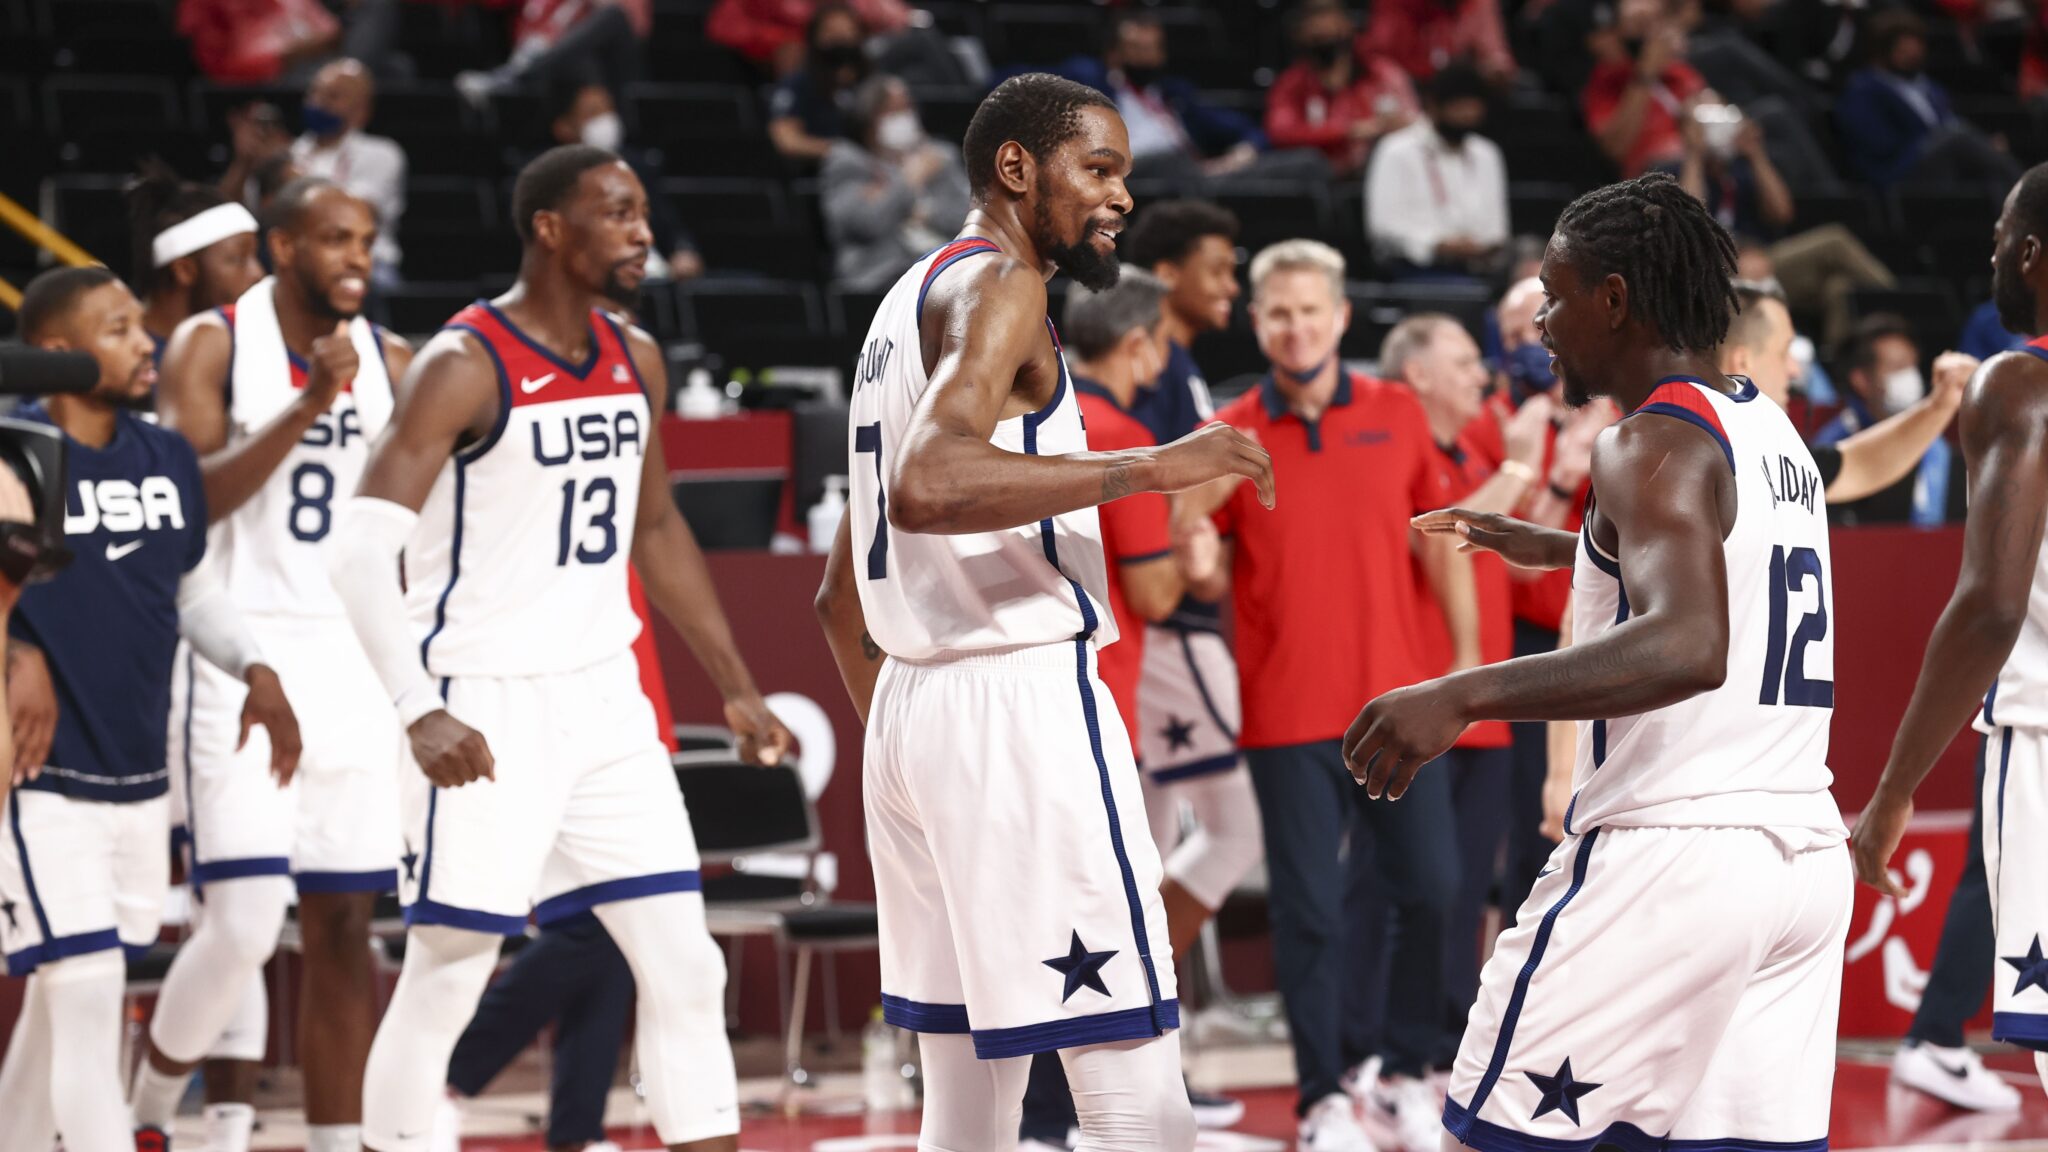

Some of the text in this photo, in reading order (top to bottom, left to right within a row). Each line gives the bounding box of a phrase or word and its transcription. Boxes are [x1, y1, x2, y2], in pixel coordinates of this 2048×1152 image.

[298, 408, 362, 448] SA
[531, 410, 641, 466] USA
[289, 461, 335, 542] 8
[557, 477, 618, 567] 13
[855, 420, 888, 580] 7
[1760, 453, 1818, 515] LIDAY
[1759, 544, 1834, 708] 12
